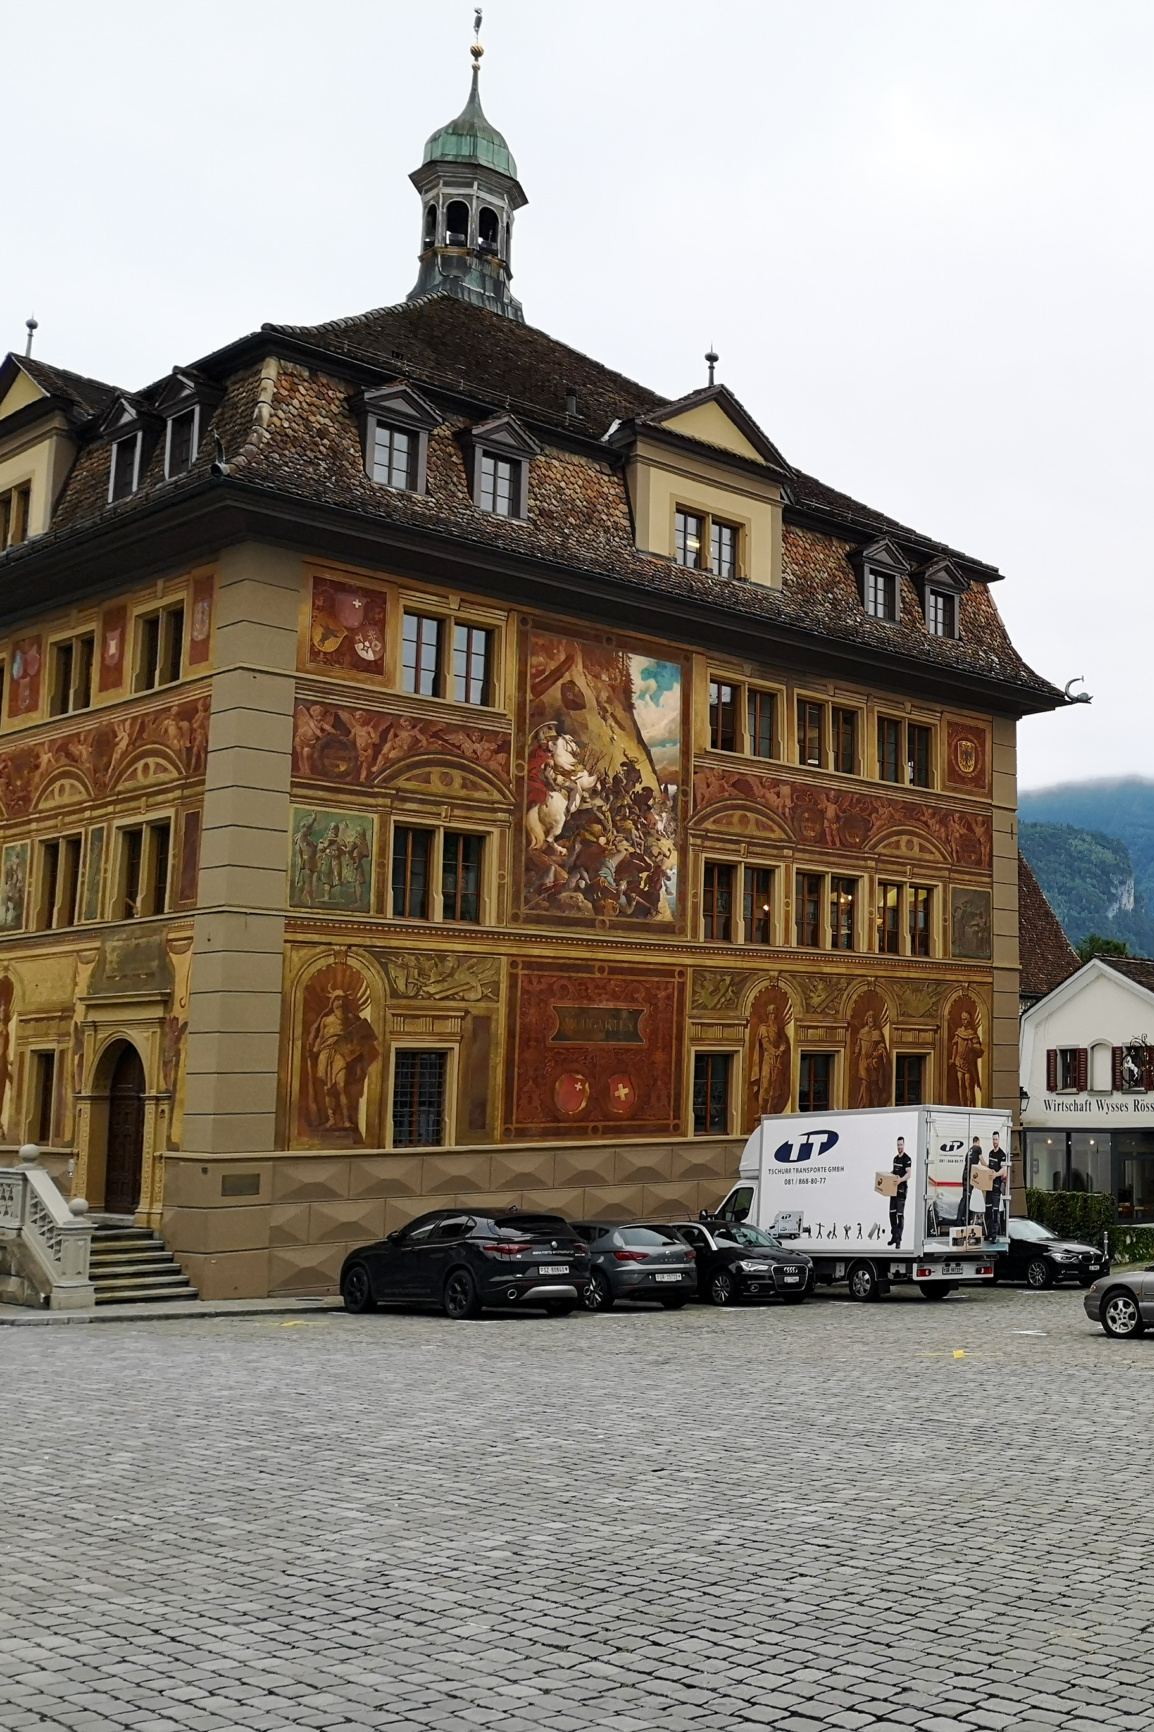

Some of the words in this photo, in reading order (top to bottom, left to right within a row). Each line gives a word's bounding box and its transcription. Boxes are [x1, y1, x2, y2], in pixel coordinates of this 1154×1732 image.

[1044, 1099, 1092, 1112] Wirtschaft
[1096, 1099, 1128, 1115] Wysses
[793, 1166, 826, 1174] TRANSPORTE
[799, 1177, 826, 1185] 868-80-77
